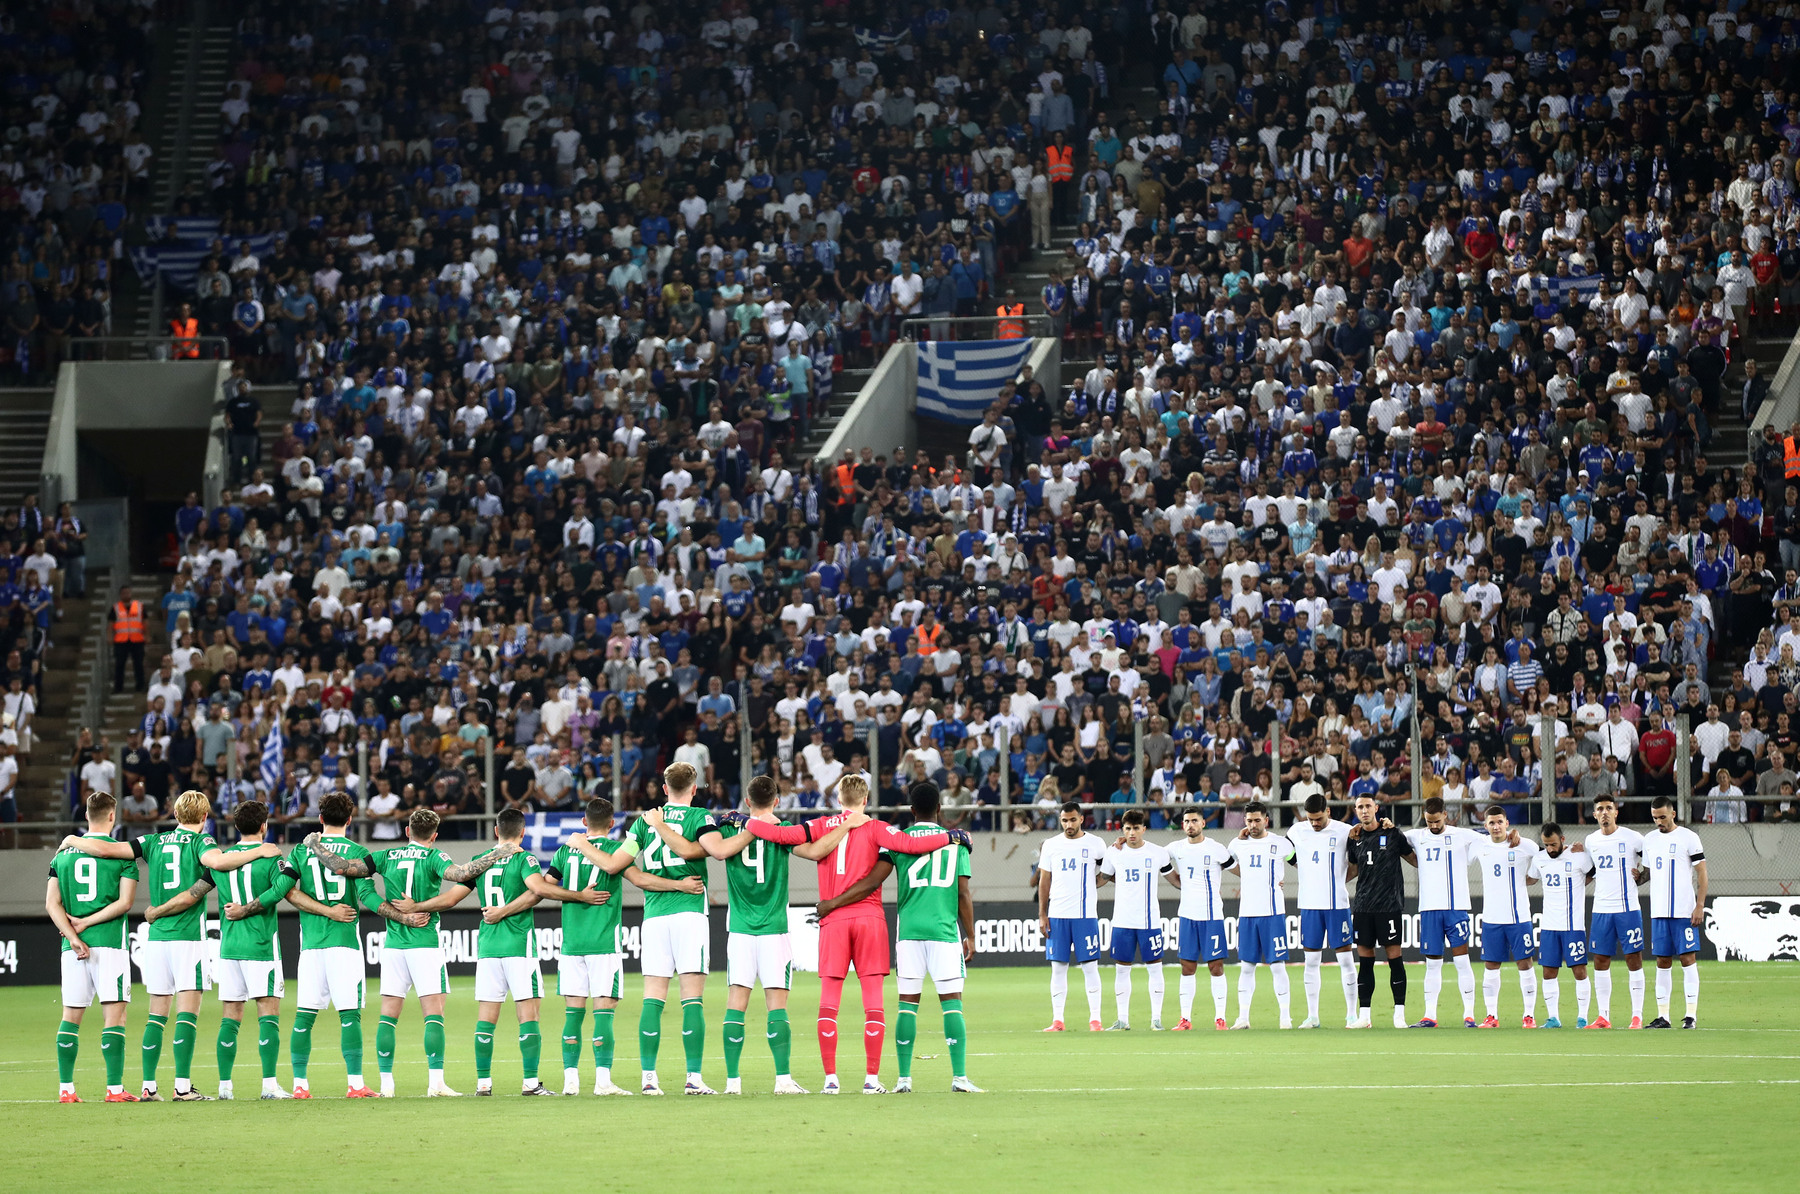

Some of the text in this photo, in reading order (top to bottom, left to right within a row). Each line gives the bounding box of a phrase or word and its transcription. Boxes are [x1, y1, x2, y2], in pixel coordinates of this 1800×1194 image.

[643, 823, 686, 870] 22
[836, 832, 850, 875] 1
[741, 839, 765, 884] 4
[1250, 854, 1262, 868] 11
[1312, 851, 1320, 863] 4
[1366, 851, 1373, 865] 1
[1426, 848, 1441, 861] 17
[1598, 855, 1613, 869] 22
[162, 844, 181, 890] 3
[908, 844, 958, 888] 20
[1061, 858, 1077, 871] 14
[1494, 864, 1502, 877] 8
[1655, 856, 1662, 870] 6
[74, 857, 97, 902] 9
[397, 861, 415, 899] 7
[567, 855, 600, 891] 17
[1125, 869, 1140, 882] 15
[1187, 866, 1194, 879] 7
[1546, 873, 1560, 886] 23
[229, 863, 255, 905] 11
[484, 868, 506, 908] 6
[1341, 920, 1350, 935] 4
[1388, 920, 1396, 934] 1
[1455, 920, 1470, 937] 17
[1684, 927, 1693, 942] 6
[975, 919, 1047, 953] GEORGE
[1085, 935, 1099, 950] 14
[1149, 934, 1162, 951] 15
[1211, 935, 1220, 949] 7
[1523, 933, 1532, 948] 8
[1626, 927, 1642, 944] 22
[1273, 936, 1287, 951] 11
[1568, 941, 1586, 957] 23
